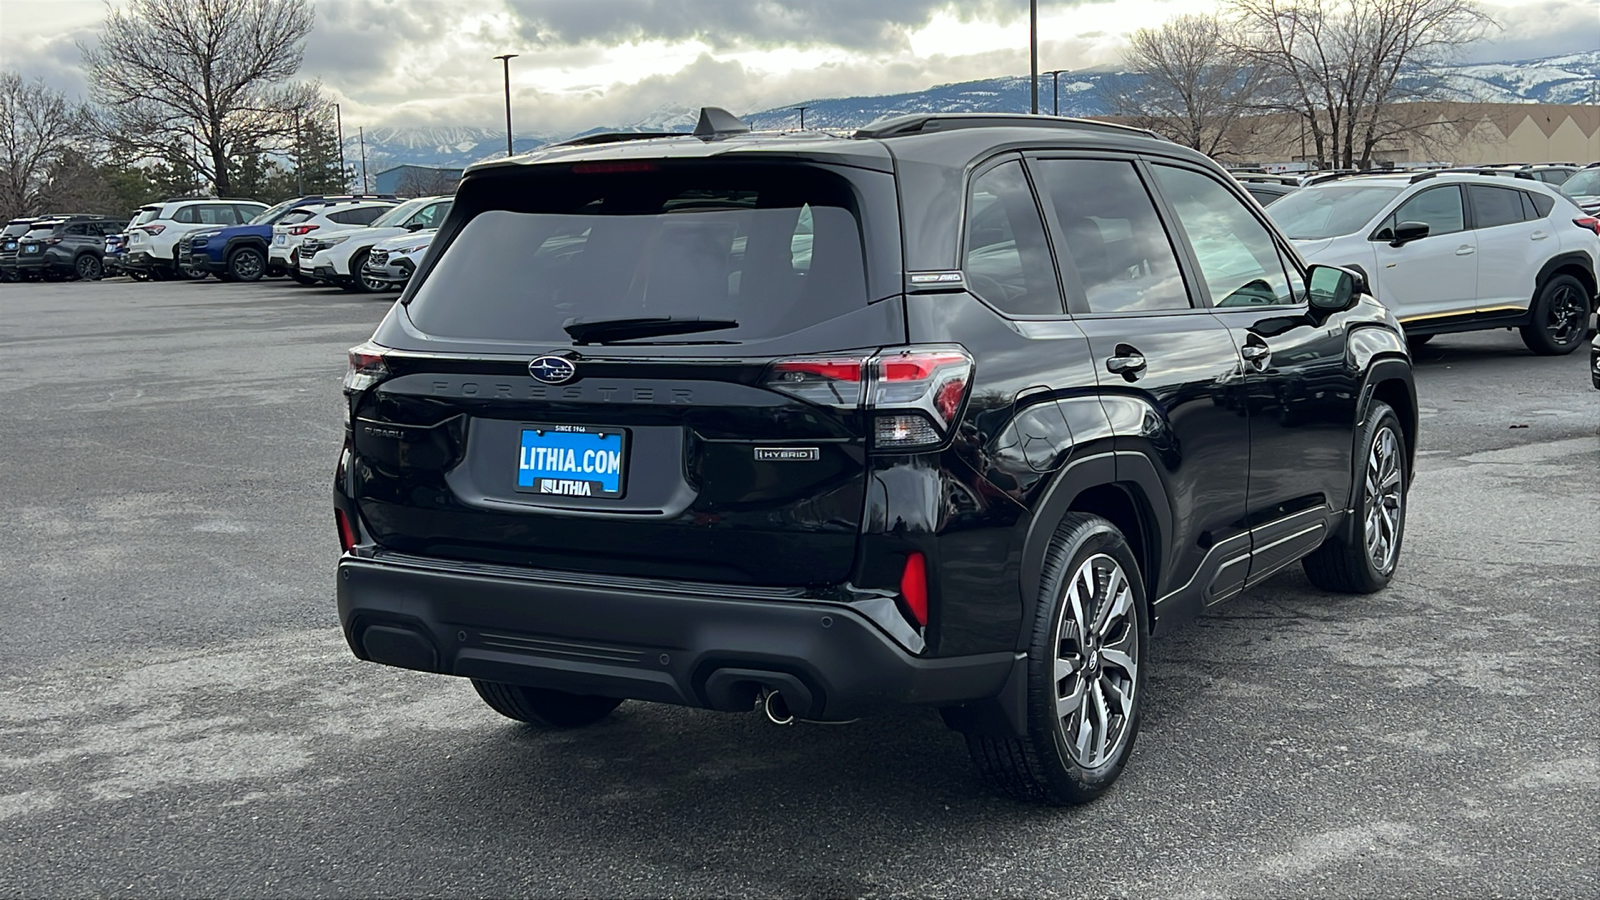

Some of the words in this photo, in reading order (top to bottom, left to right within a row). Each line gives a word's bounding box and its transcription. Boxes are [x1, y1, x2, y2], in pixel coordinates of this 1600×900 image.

[431, 381, 694, 403] FORESTER
[364, 426, 404, 439] SUBARU
[520, 446, 621, 475] LITHIA.COM
[552, 479, 592, 496] LITHIA
